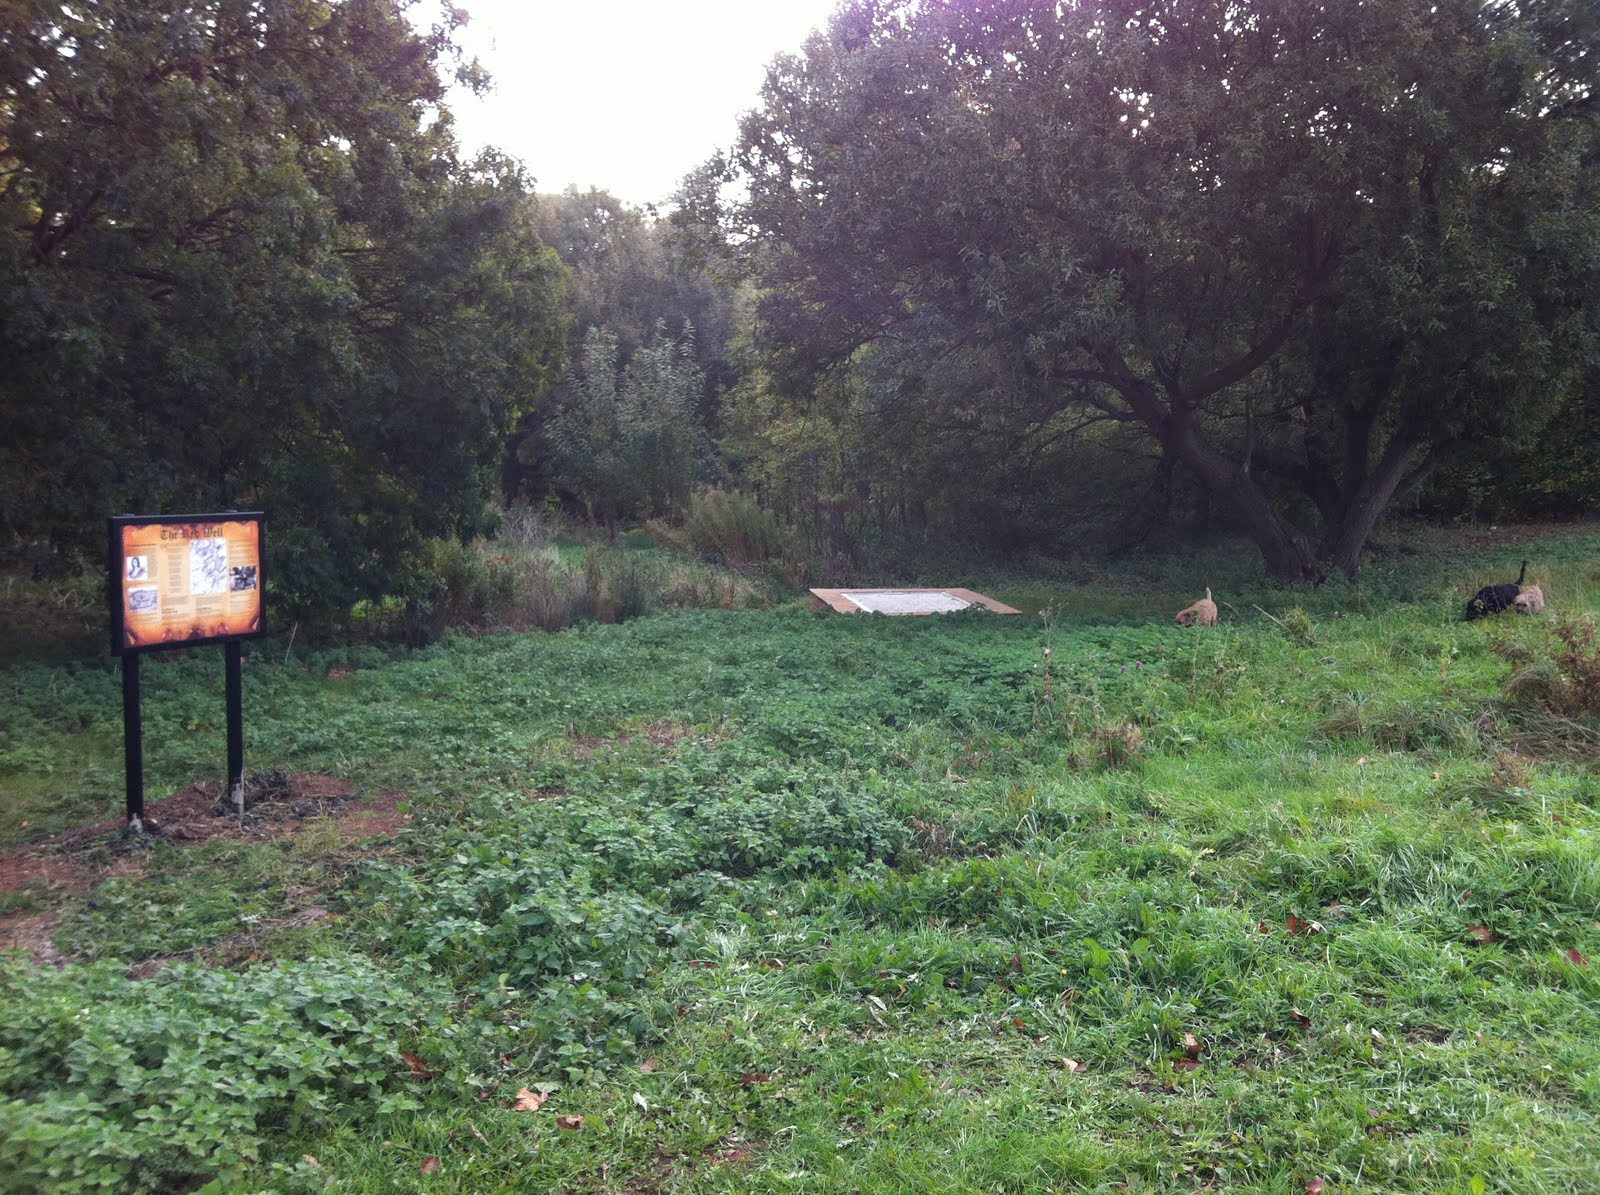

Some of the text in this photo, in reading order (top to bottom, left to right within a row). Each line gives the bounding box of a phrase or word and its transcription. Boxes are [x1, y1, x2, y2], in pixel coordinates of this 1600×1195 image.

[160, 527, 223, 540] The Red Well
